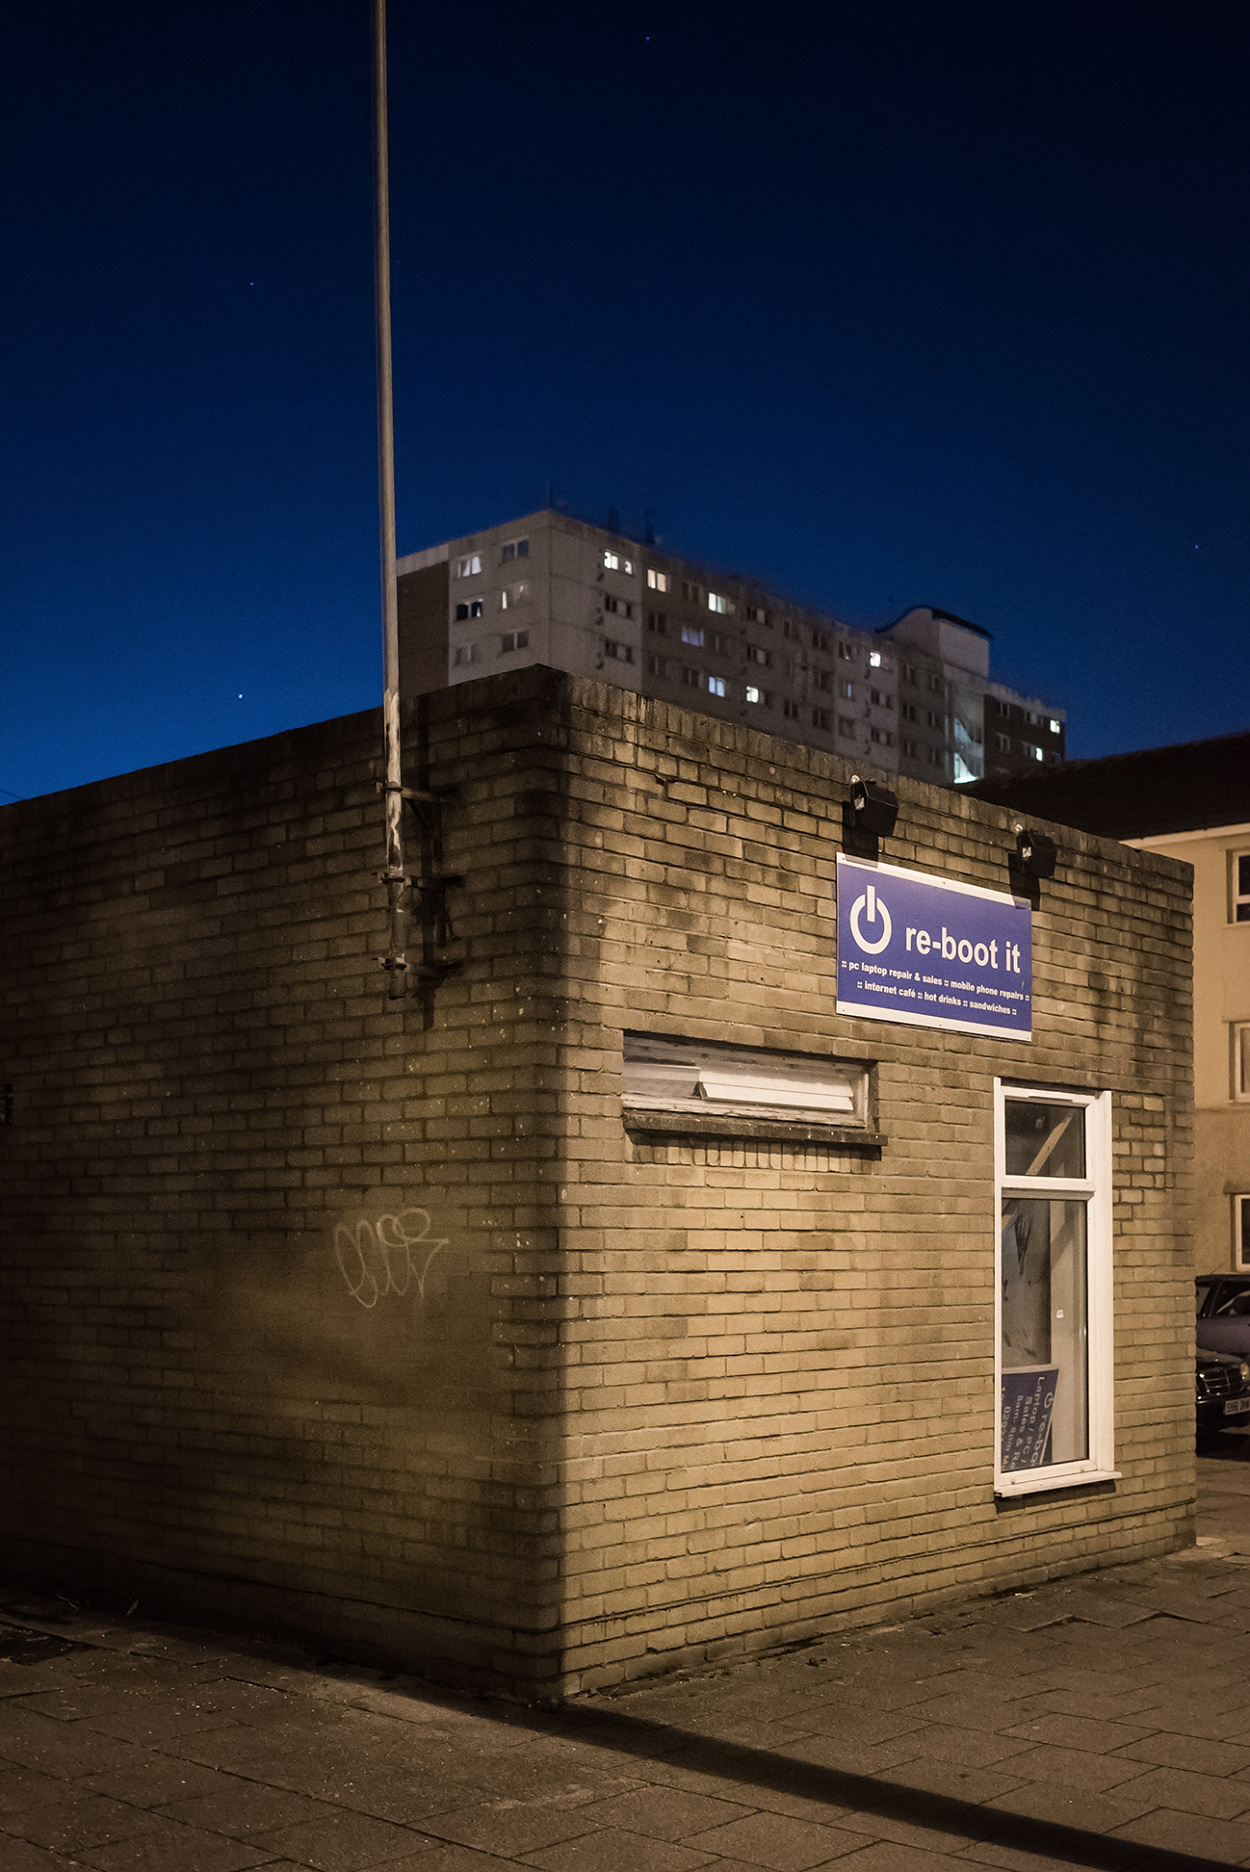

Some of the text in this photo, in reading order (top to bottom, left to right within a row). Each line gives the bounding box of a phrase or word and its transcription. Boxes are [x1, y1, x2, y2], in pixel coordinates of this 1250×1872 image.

[905, 926, 1021, 974] re-boot it
[848, 961, 860, 971] pc
[861, 962, 888, 977] laptop
[889, 969, 913, 980] repair
[914, 972, 921, 981] &
[922, 975, 942, 986] sales
[950, 980, 975, 992] mobile
[976, 985, 998, 996] phone
[999, 990, 1024, 1000] repairs
[864, 980, 897, 995] internet
[898, 988, 916, 998] café
[924, 991, 937, 1002] hot
[938, 994, 962, 1006] drinks
[969, 1001, 1011, 1015] sandwiches
[1030, 1376, 1045, 1424] Laptop
[1031, 1414, 1048, 1466] re-bo
